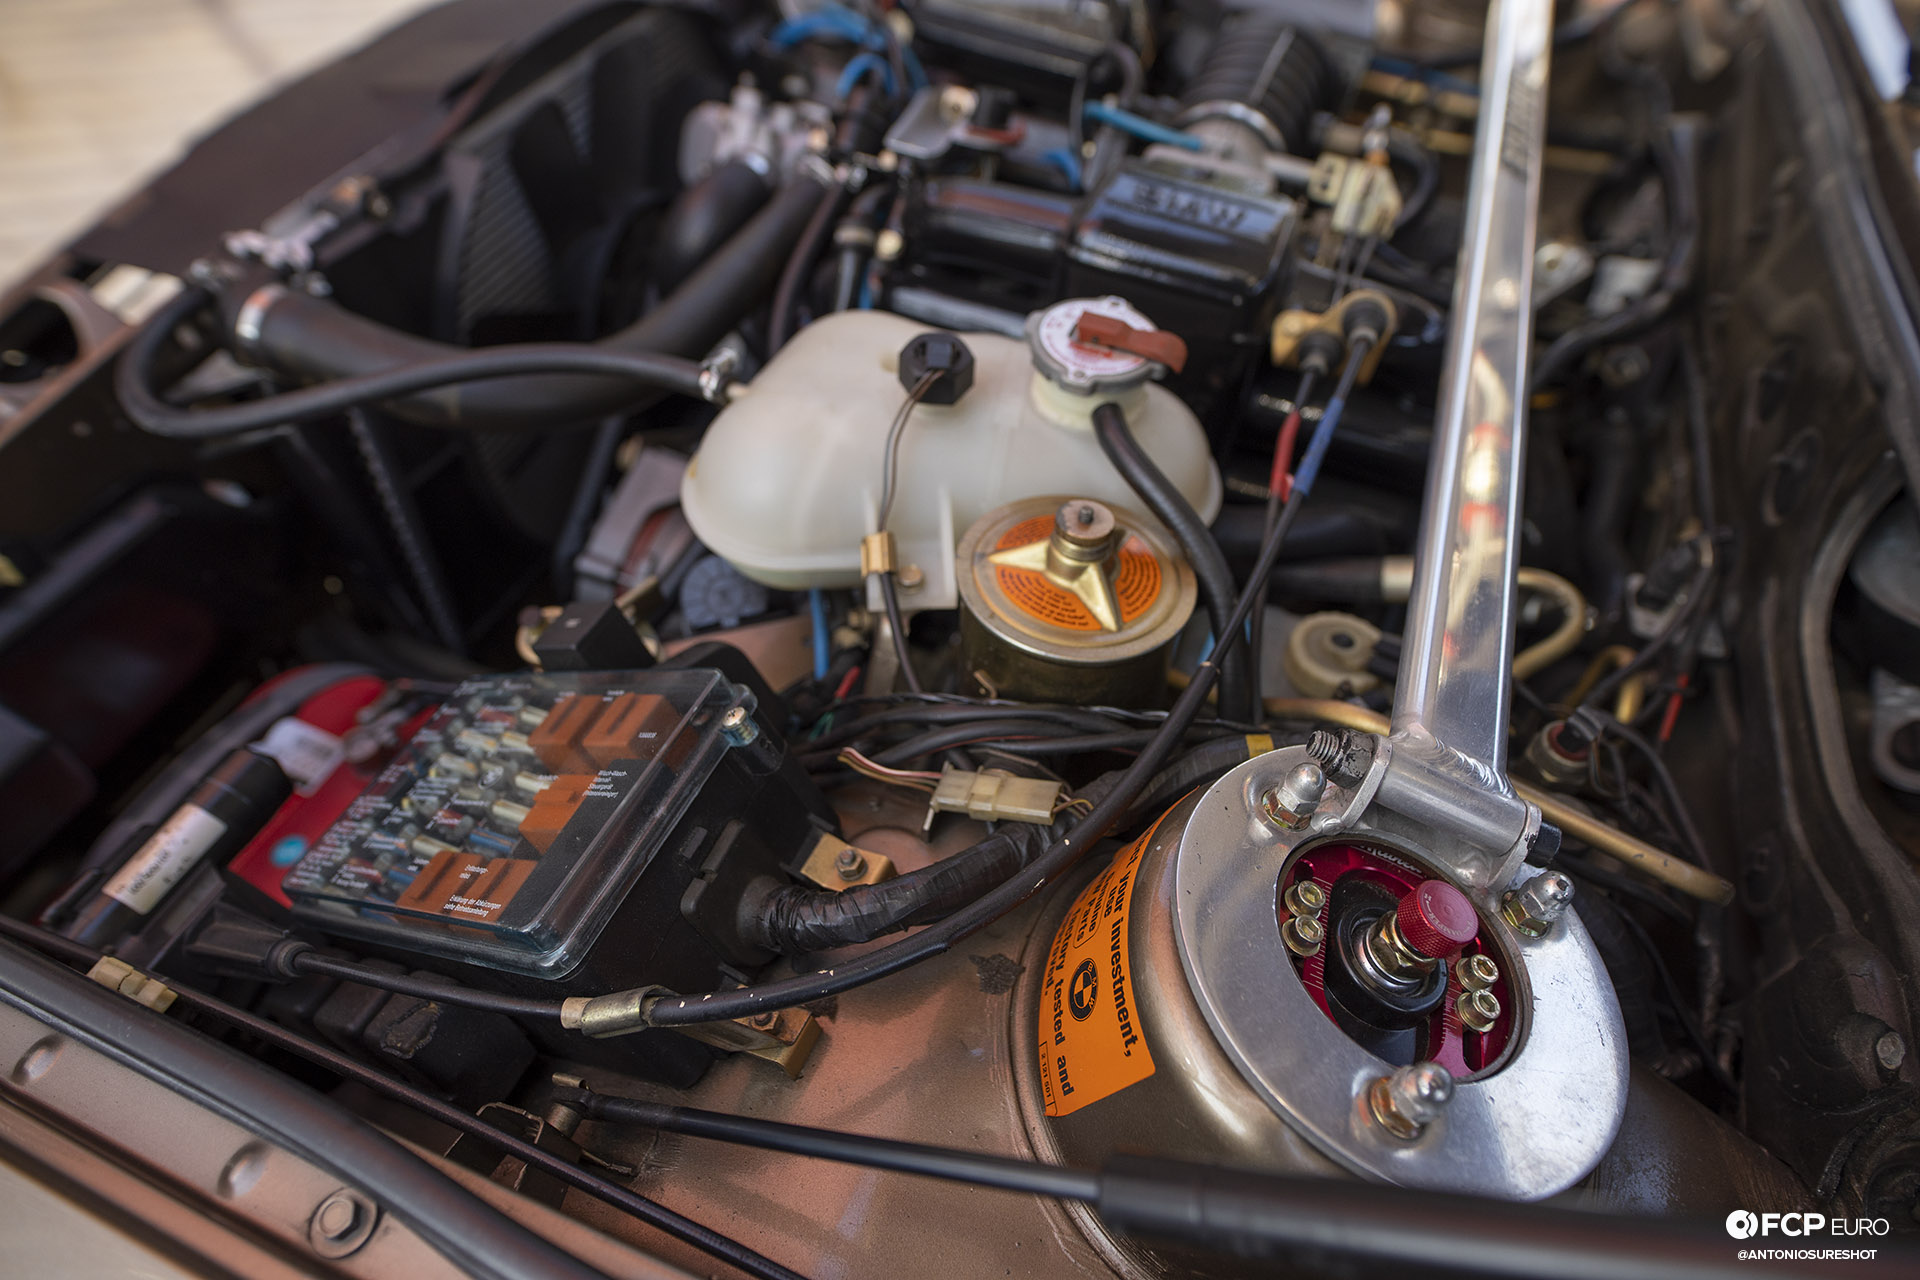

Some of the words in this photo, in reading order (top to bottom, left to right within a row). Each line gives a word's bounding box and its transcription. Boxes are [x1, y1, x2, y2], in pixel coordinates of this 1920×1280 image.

[1104, 885, 1118, 918] use
[1113, 870, 1131, 913] your
[1055, 907, 1081, 971] factory
[1077, 897, 1097, 942] Parts
[1429, 912, 1463, 936] DAMPER
[1110, 916, 1138, 1058] investment,
[1053, 978, 1066, 1046] tested
[1057, 1055, 1075, 1097] and
